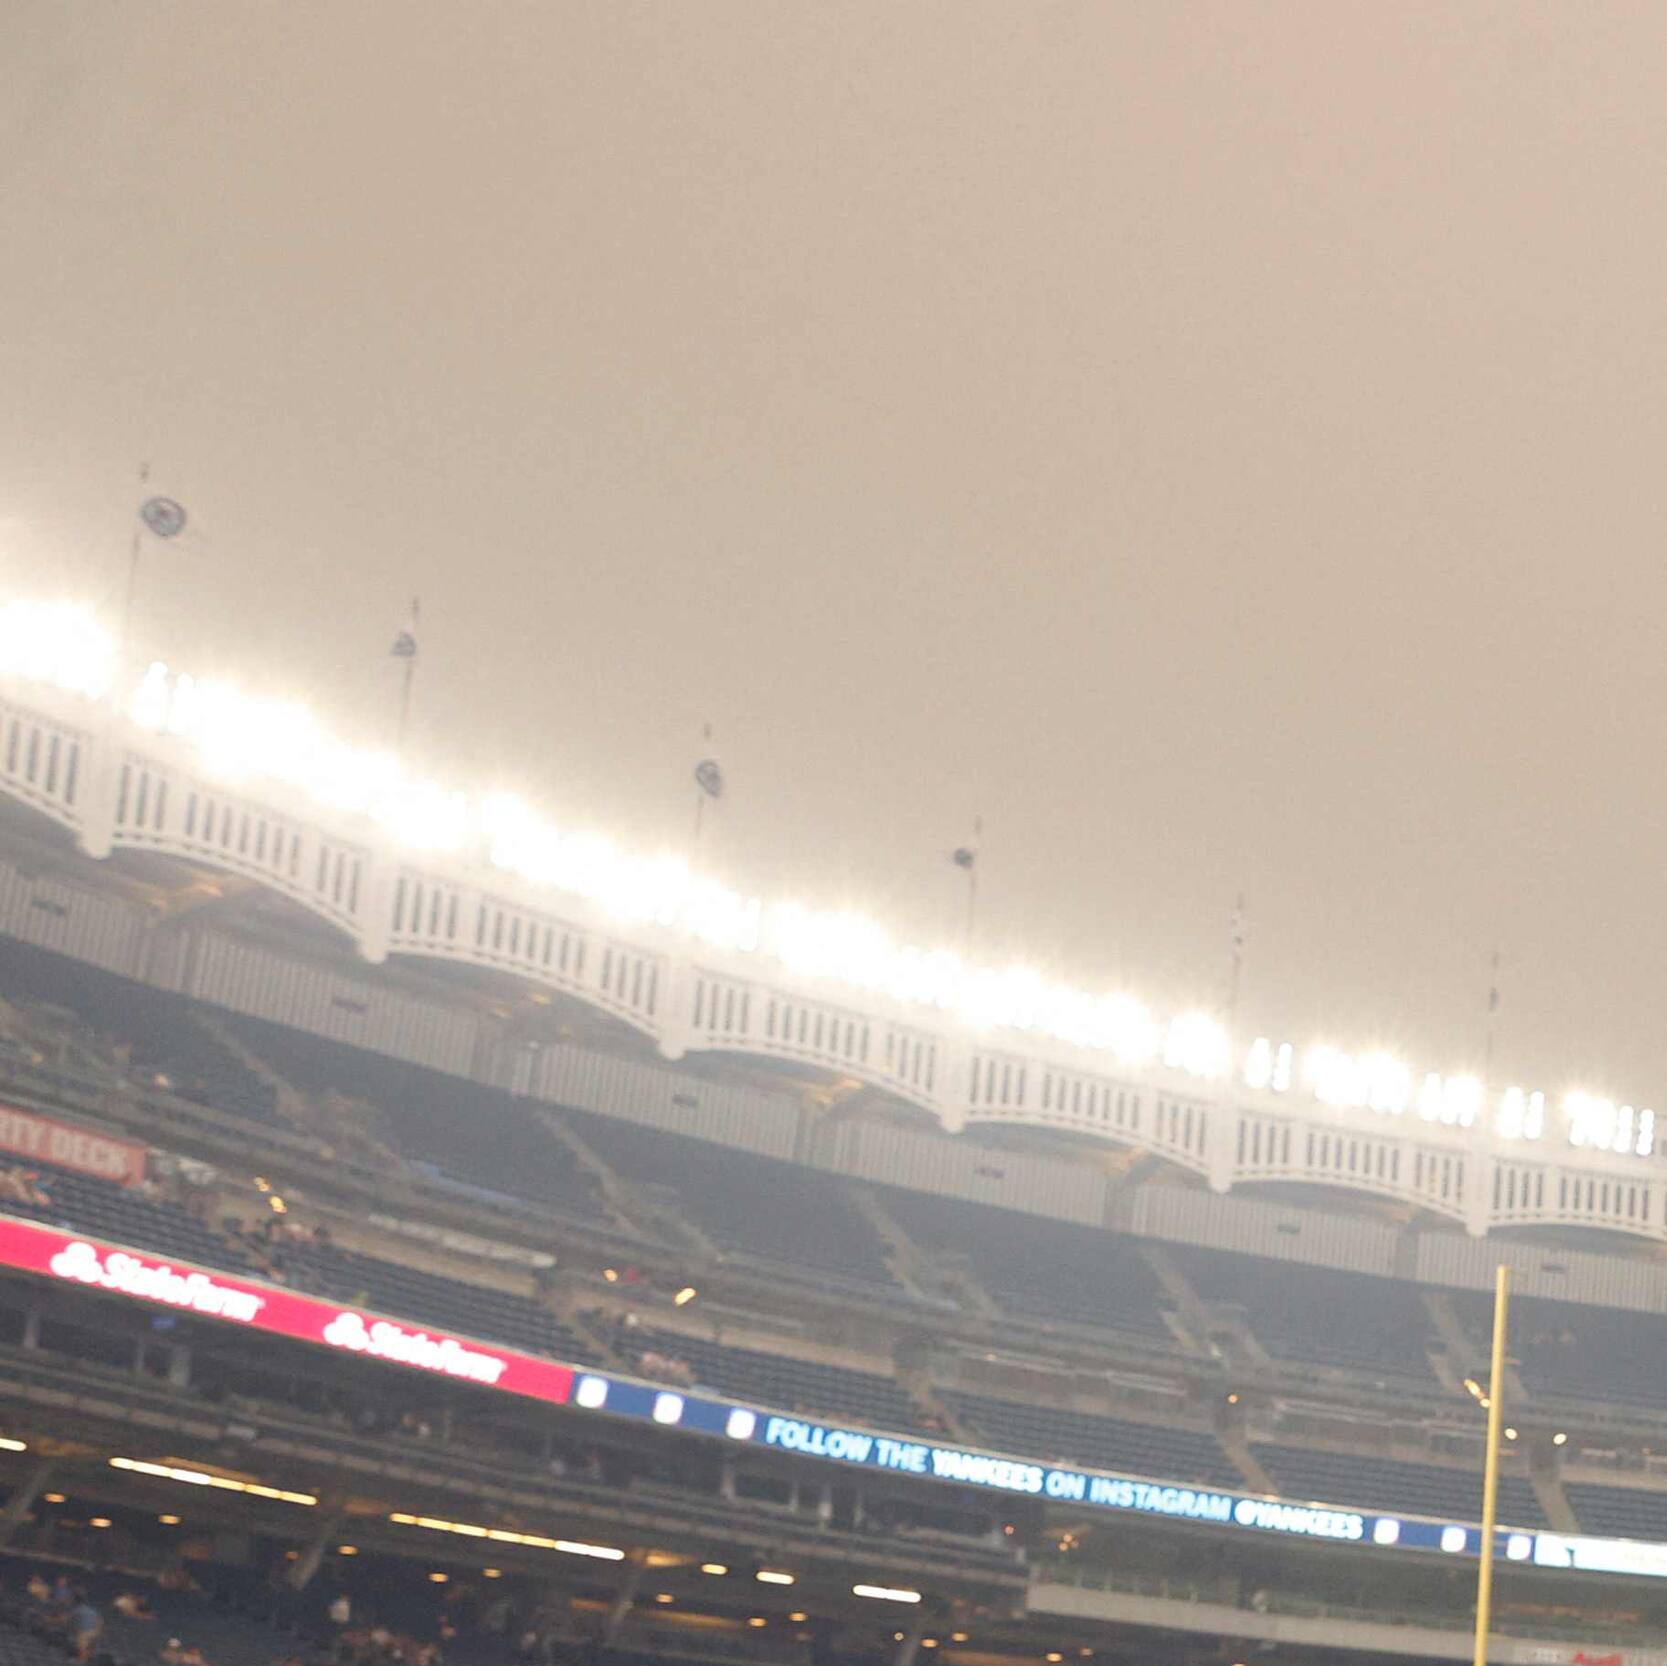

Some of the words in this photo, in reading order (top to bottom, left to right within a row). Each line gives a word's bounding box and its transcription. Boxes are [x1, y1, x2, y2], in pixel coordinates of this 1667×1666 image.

[765, 1416, 873, 1462] FOLLOW
[875, 1437, 929, 1473] THE
[931, 1449, 1043, 1493] YANKEES
[1045, 1470, 1086, 1499] ON
[1089, 1477, 1232, 1522] INSTAGRAM
